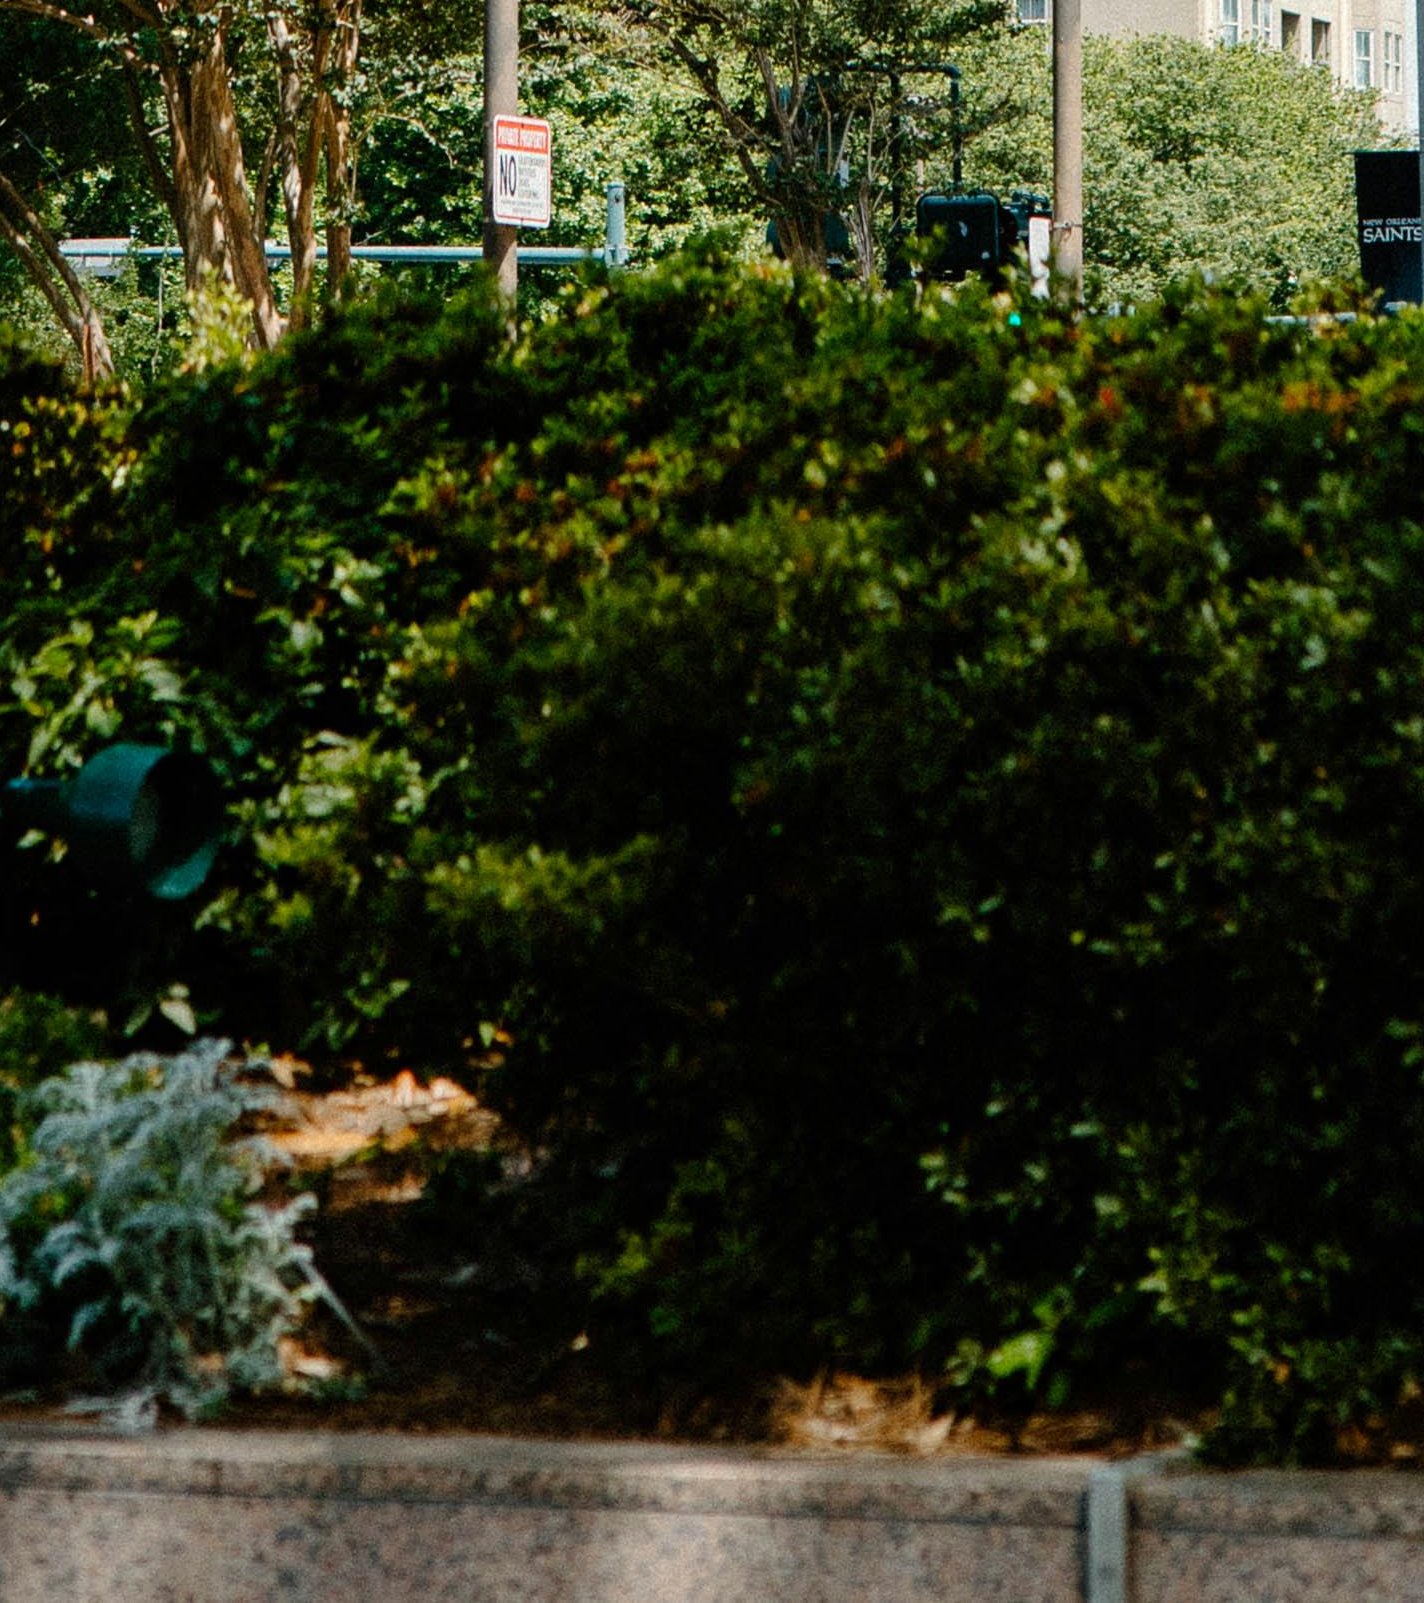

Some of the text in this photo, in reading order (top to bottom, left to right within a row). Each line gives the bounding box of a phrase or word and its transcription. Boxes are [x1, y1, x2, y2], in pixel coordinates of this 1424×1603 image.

[500, 154, 517, 197] NO
[1362, 217, 1423, 227] NEW ORLEAN
[1363, 226, 1423, 243] SAINTS
